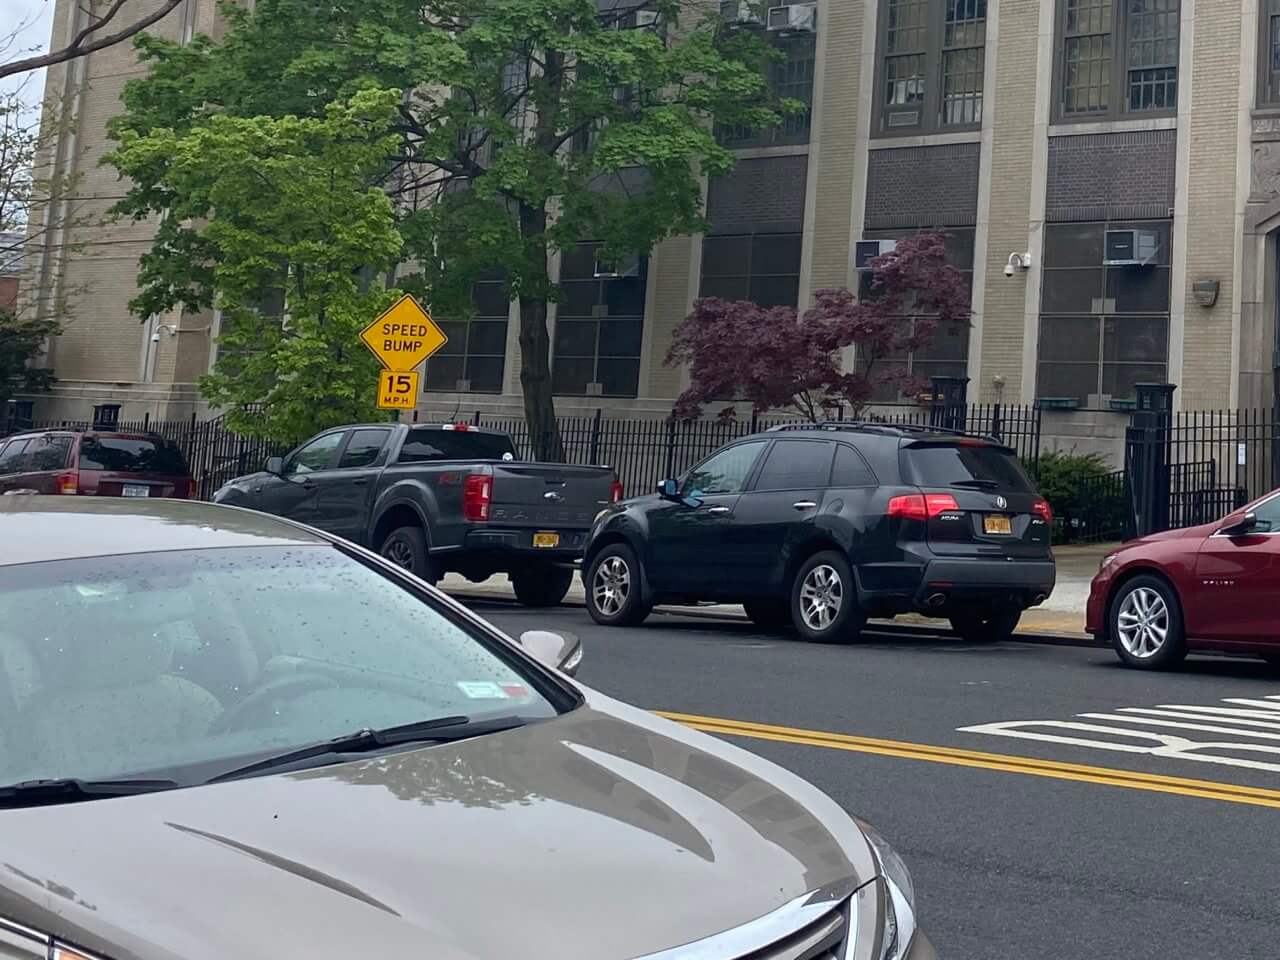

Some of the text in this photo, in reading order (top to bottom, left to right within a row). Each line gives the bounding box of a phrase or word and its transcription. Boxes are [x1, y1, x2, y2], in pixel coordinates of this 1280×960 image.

[382, 323, 428, 337] SPEED
[383, 339, 423, 353] BUMP
[387, 375, 411, 394] 15
